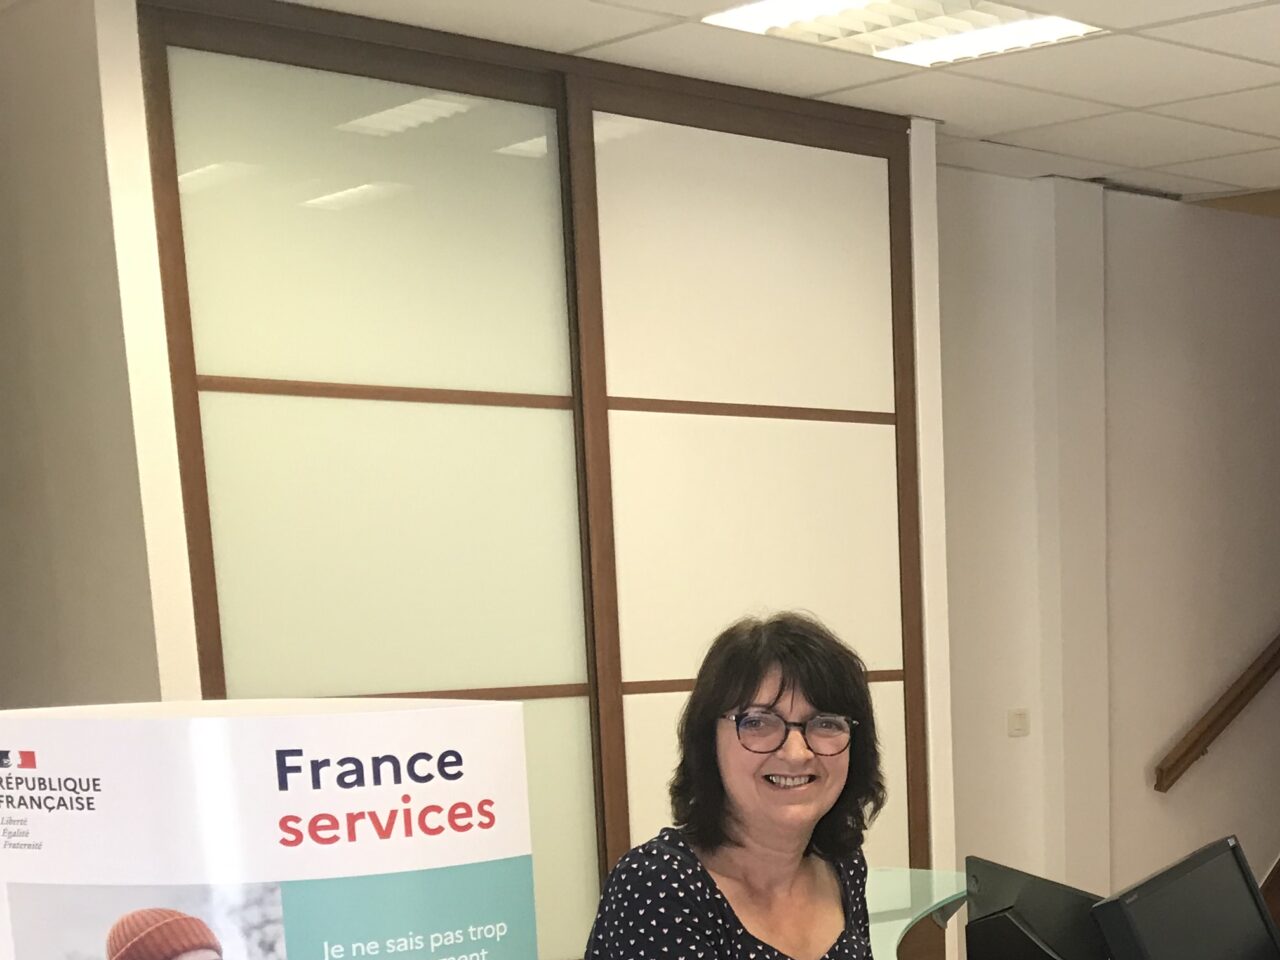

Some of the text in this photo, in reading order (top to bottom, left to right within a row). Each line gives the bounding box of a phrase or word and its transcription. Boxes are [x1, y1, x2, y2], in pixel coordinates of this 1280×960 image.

[275, 749, 464, 791] France
[0, 817, 28, 826] Liberté
[279, 794, 496, 847] services
[352, 941, 379, 956] ne
[386, 932, 424, 953] sais
[430, 929, 463, 952] pas
[468, 922, 508, 941] trop
